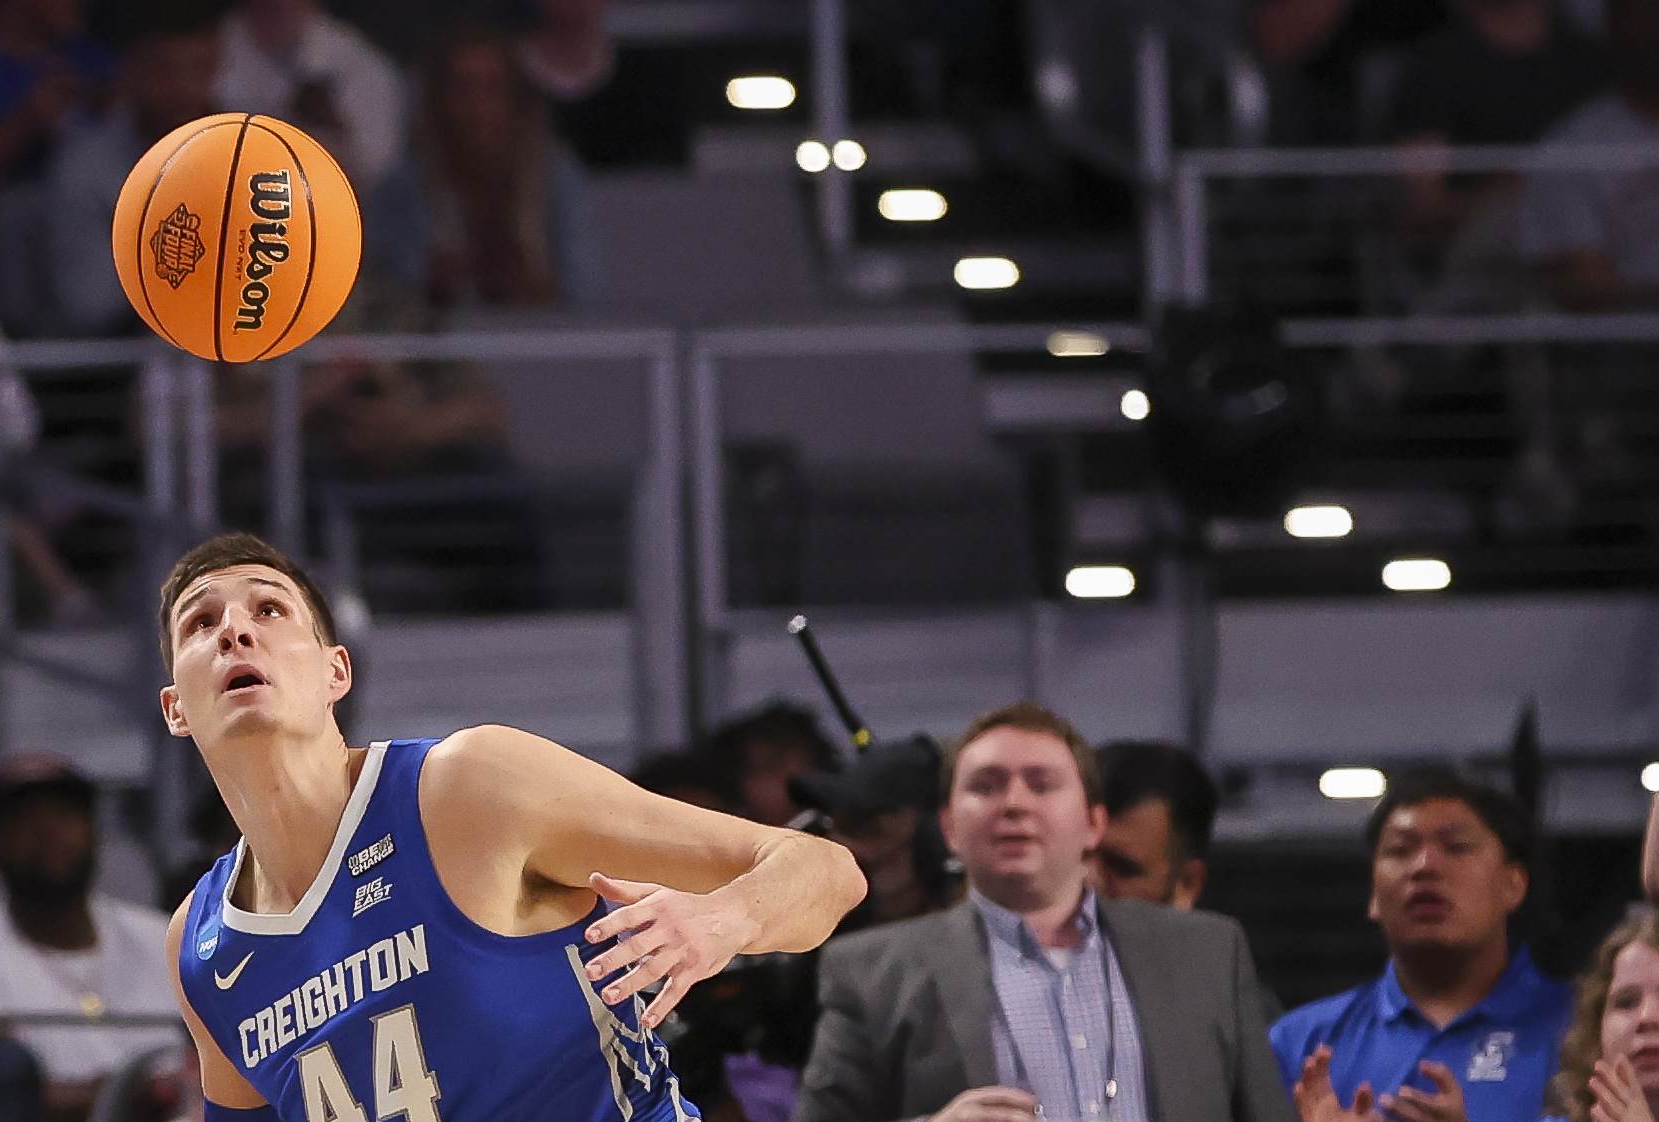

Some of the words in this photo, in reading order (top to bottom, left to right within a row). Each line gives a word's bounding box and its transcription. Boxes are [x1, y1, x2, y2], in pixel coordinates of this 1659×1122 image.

[162, 224, 181, 270] FOUR
[178, 229, 197, 272] FINAL
[235, 169, 291, 332] Wilson
[351, 842, 395, 876] CHANGE
[353, 883, 393, 911] EAST
[355, 876, 384, 899] BIG
[237, 923, 430, 1069] CREIGHTON
